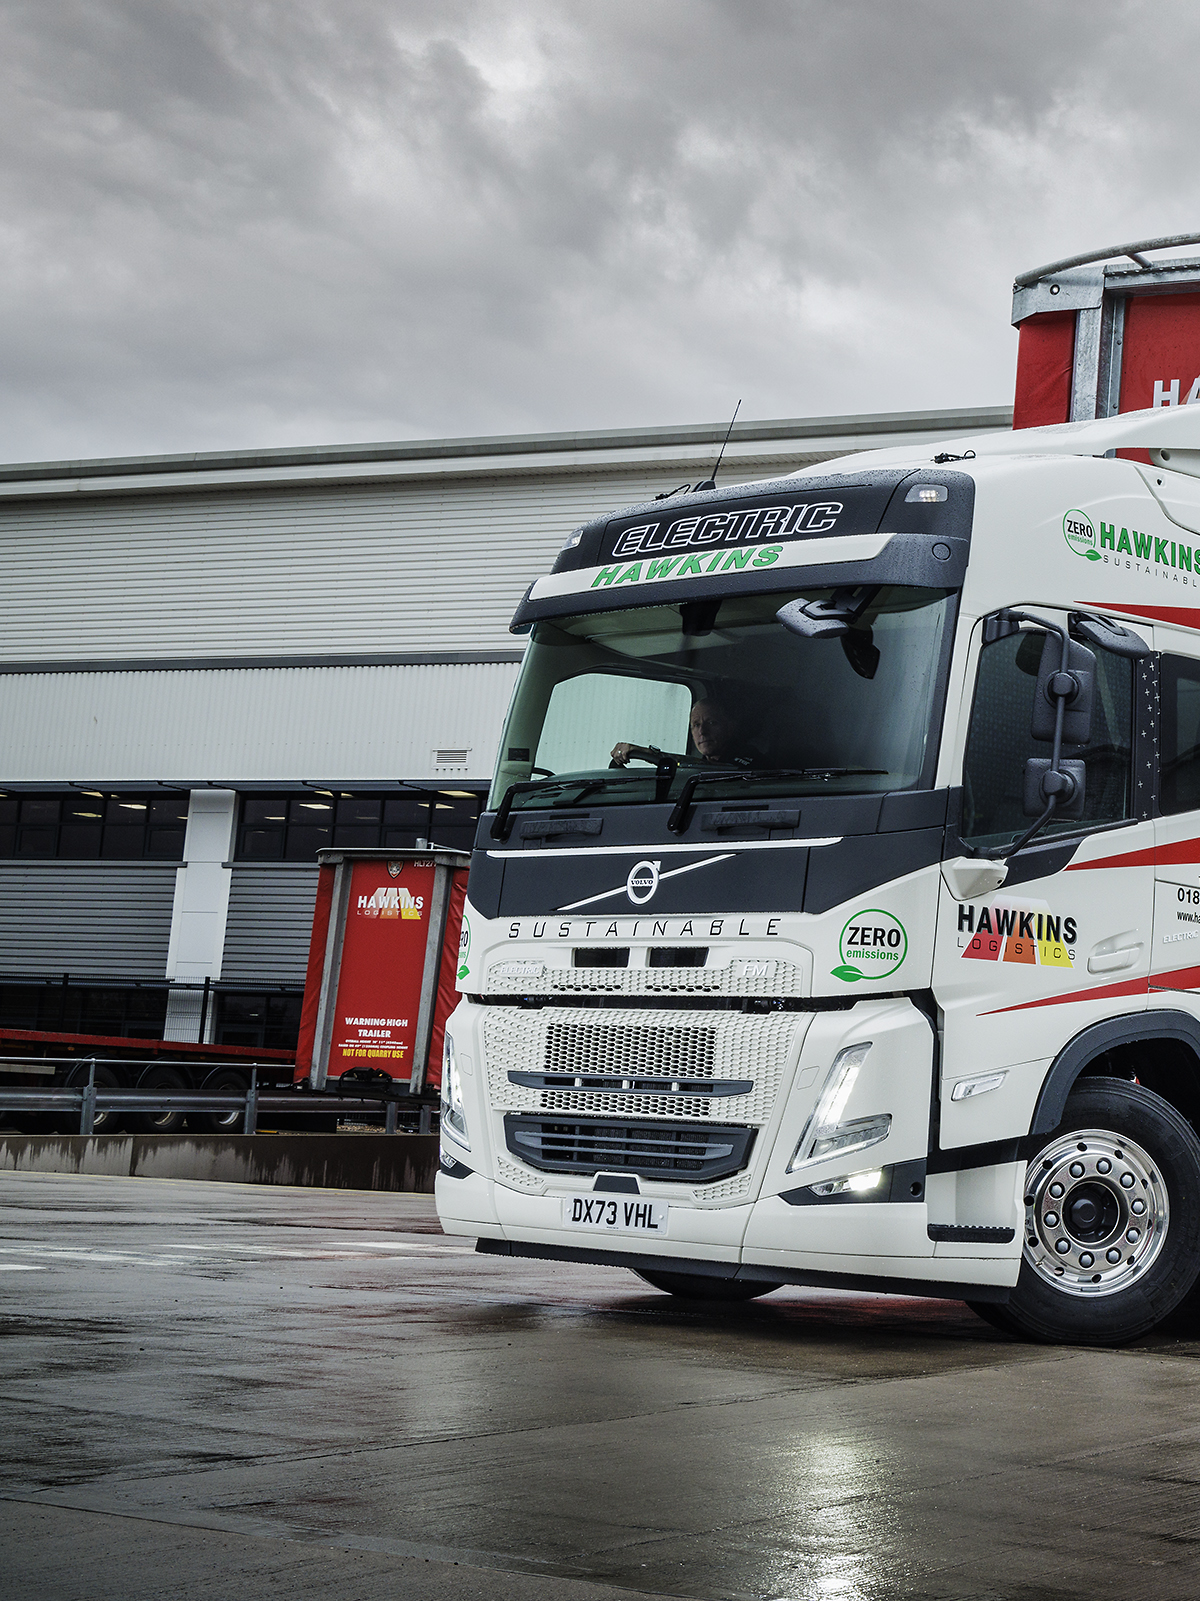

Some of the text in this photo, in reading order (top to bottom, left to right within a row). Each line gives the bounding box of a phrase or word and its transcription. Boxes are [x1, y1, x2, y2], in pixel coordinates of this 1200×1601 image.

[612, 502, 843, 557] ELECTRIC
[1066, 519, 1093, 538] ZERO
[1067, 533, 1093, 546] emissions
[590, 545, 784, 588] HAWKINS
[357, 895, 424, 909] HAWKINS
[508, 918, 782, 939] SUSTAINABLE
[957, 903, 1078, 945] HAWKINS
[847, 927, 900, 947] ZERO
[1163, 930, 1199, 944] ELECTRIC
[846, 948, 899, 961] emissions
[957, 937, 1076, 961] LOGISTICS
[742, 964, 768, 976] FM
[345, 1017, 408, 1027] WARNING HIGH
[358, 1029, 391, 1038] TRAILER
[342, 1048, 404, 1058] NOT FOR QUARRY USE
[572, 1198, 658, 1229] DX73 VHL
